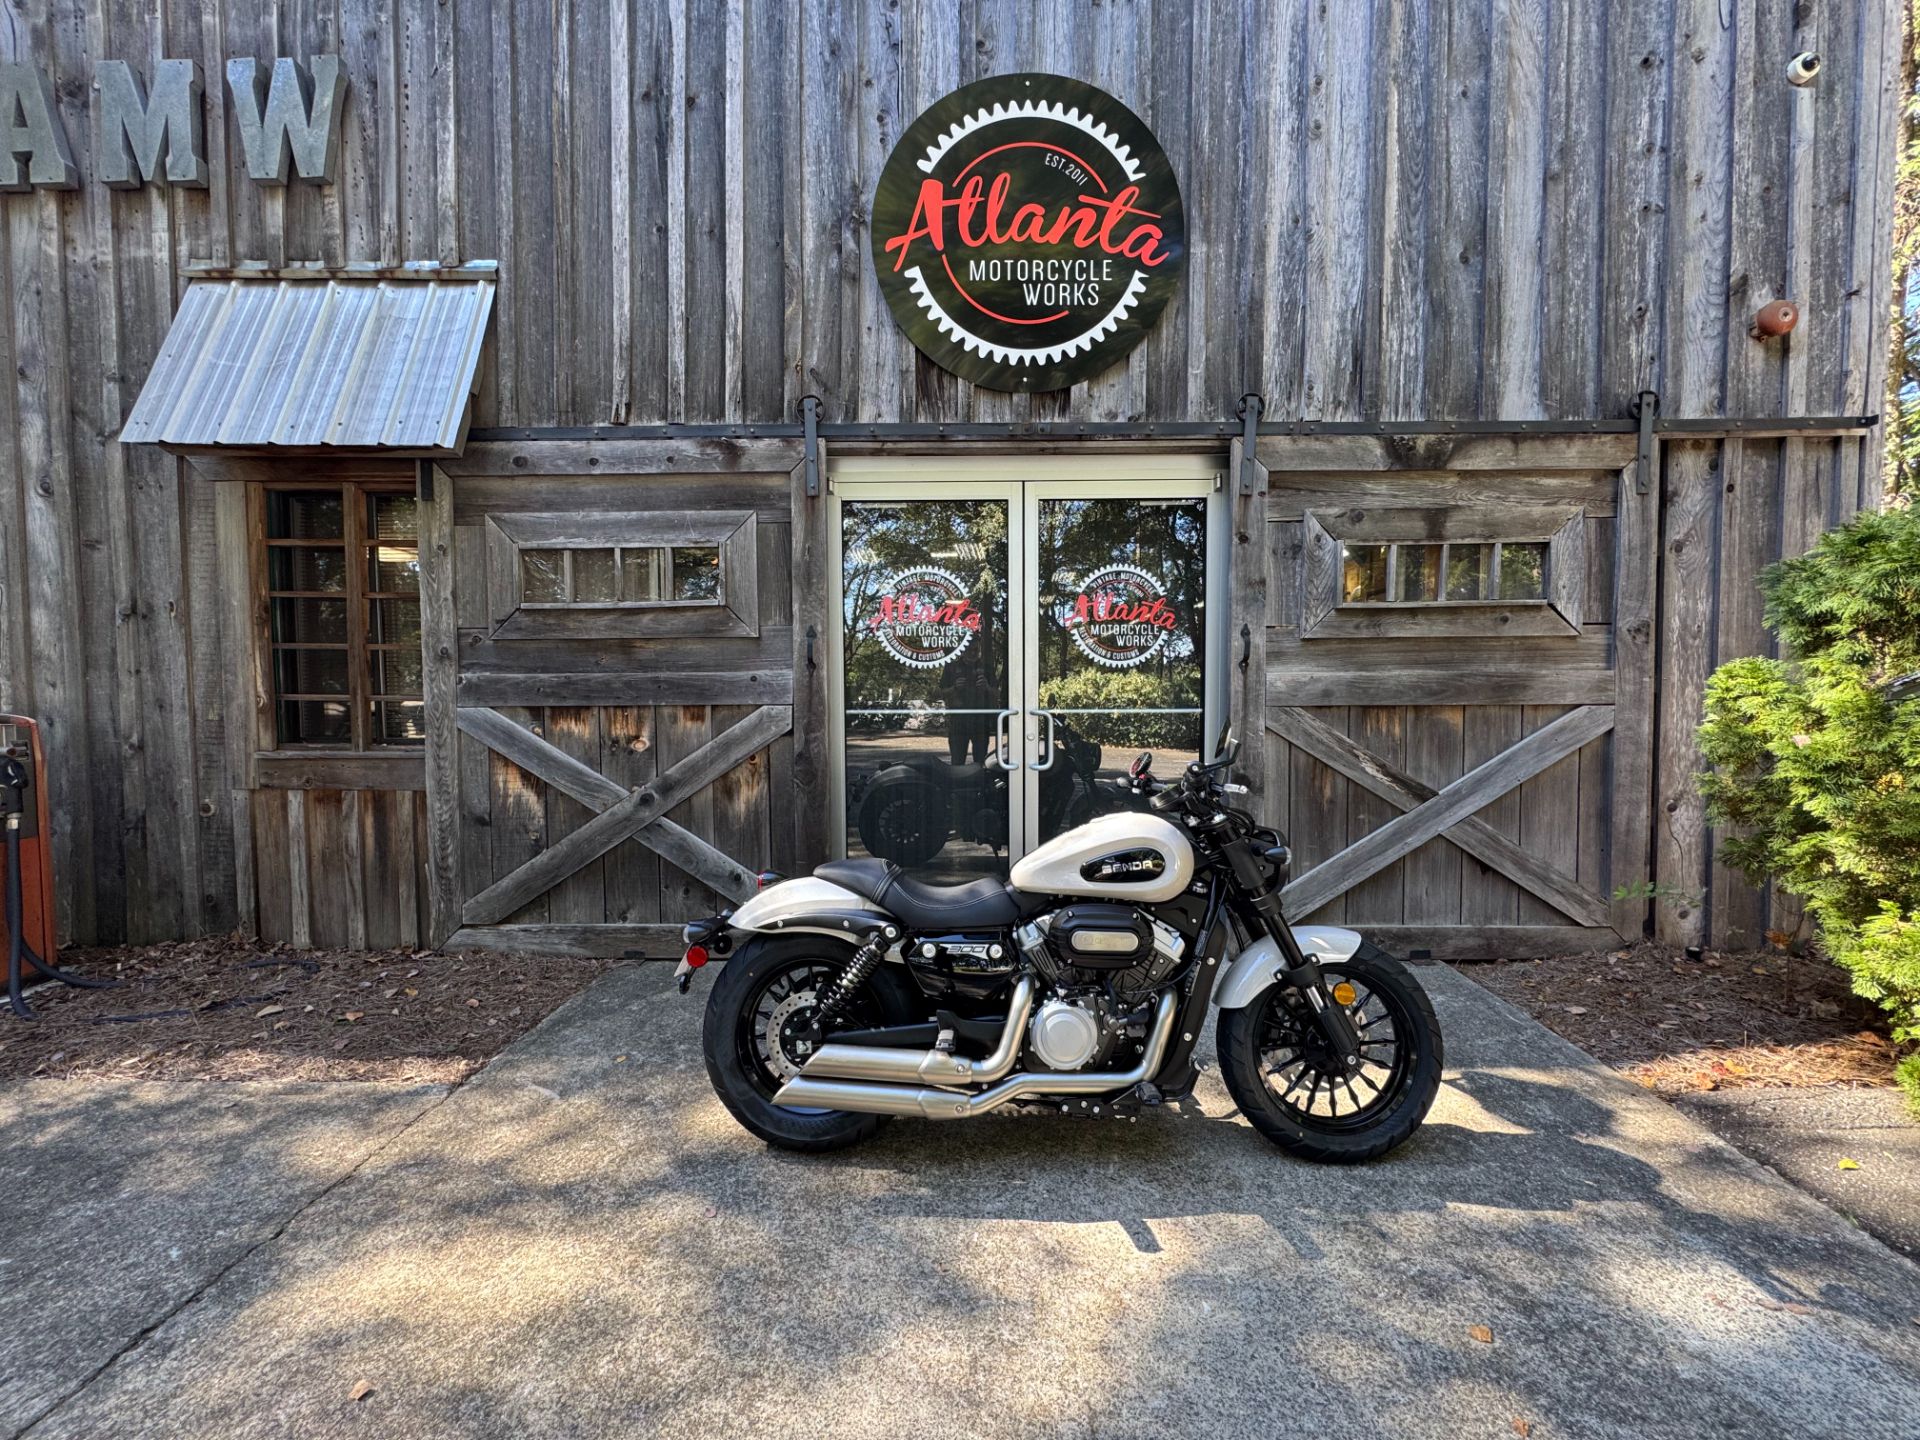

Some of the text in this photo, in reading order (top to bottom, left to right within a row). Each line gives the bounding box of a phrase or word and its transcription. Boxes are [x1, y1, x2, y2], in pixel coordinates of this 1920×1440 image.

[0, 55, 344, 187] AMW
[884, 172, 1171, 272] Atlanta
[969, 259, 1113, 281] MOTORCYCLE
[1023, 283, 1099, 306] WORKS
[868, 591, 983, 634] Atlanta
[1063, 591, 1179, 632] Atlanta
[896, 625, 965, 637] MOTORCYCLE
[1090, 624, 1160, 636] MOTORCYCLE
[921, 636, 959, 648] WORKS
[1116, 635, 1154, 648] WORKS
[1101, 859, 1153, 874] BENDA
